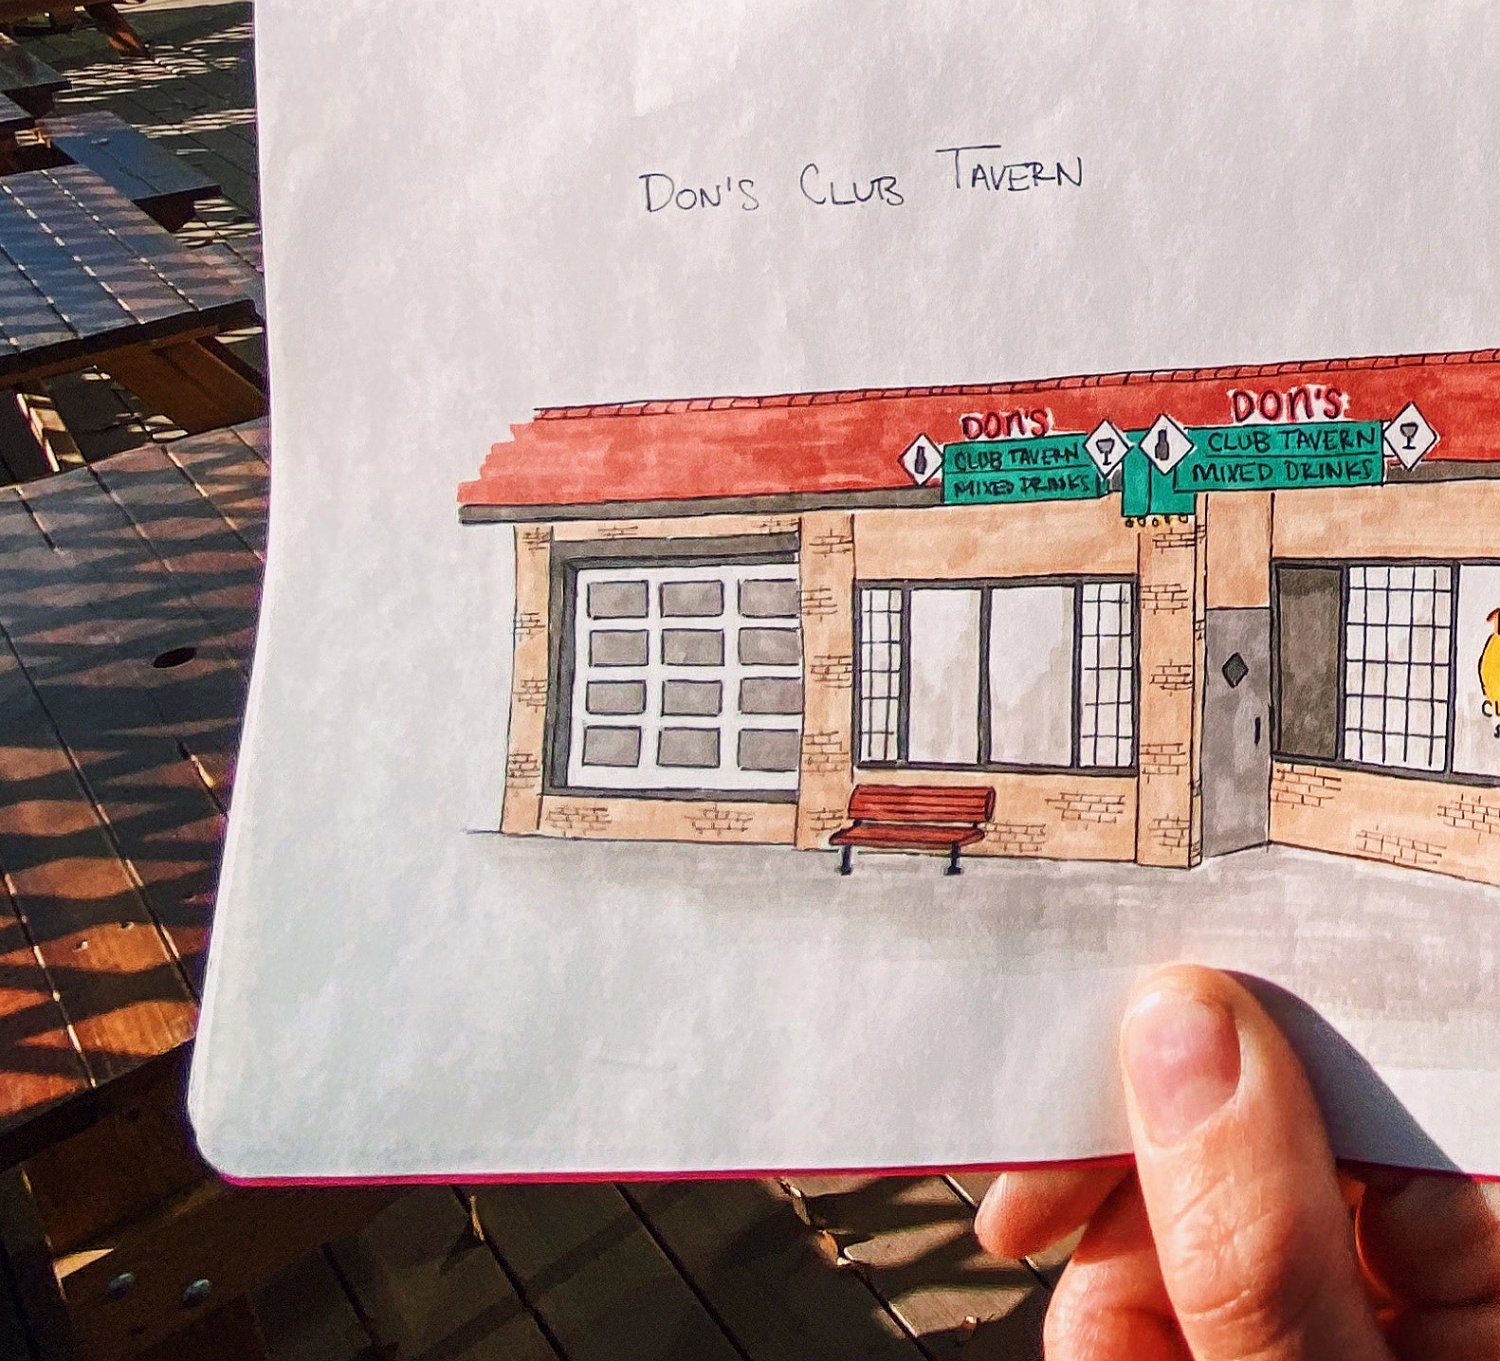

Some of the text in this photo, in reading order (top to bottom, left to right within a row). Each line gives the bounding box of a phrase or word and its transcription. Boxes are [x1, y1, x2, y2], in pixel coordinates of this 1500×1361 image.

[799, 162, 905, 207] CLUB
[936, 144, 1084, 191] TAVERN
[1207, 425, 1377, 453] CLUB TAVERN
[953, 444, 1081, 473] CLUB TAVERN
[1192, 457, 1374, 486] MIXED DRINKS
